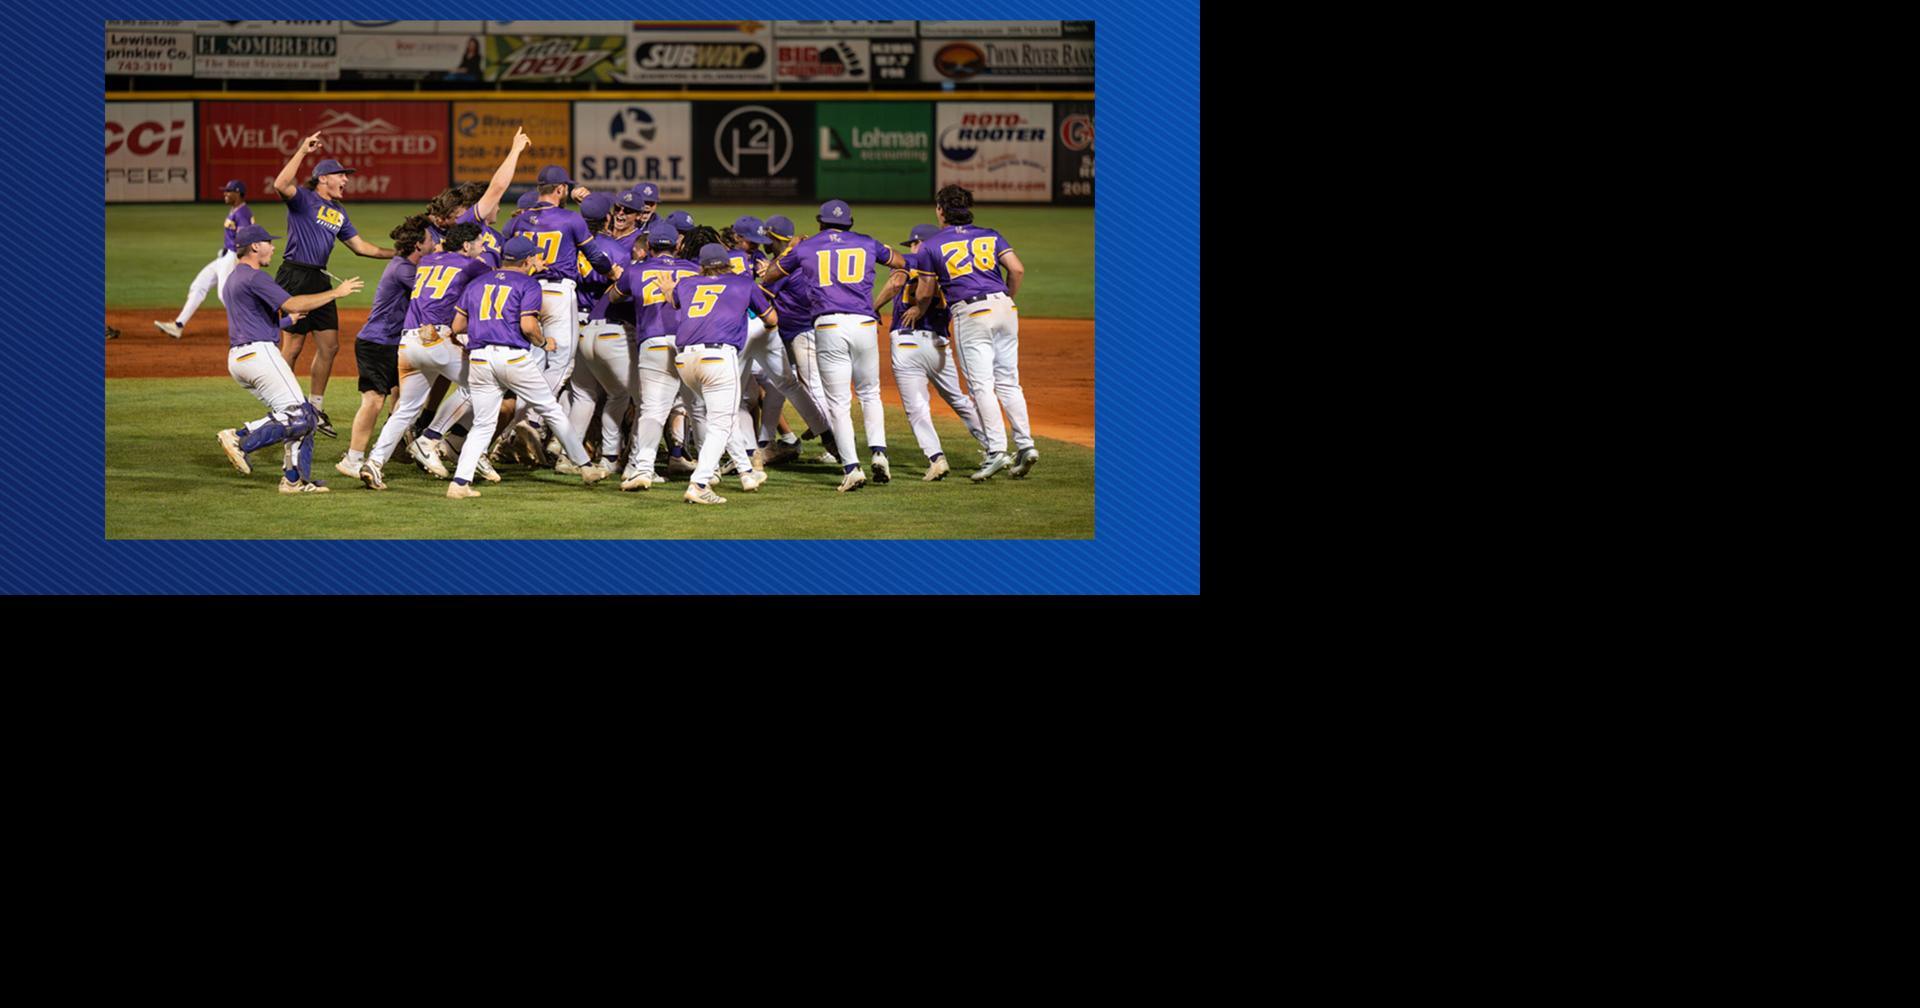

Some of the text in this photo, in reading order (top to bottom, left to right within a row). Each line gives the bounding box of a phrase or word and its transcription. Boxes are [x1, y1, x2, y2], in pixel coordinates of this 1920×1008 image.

[112, 34, 176, 46] Lewiston
[199, 37, 335, 54] EL SOMBRERO
[106, 48, 190, 61] prinkler Co.
[640, 44, 758, 67] SUBWAY
[779, 47, 817, 62] BIG
[985, 44, 1018, 65] TWIN
[1021, 44, 1058, 65] RIVER
[118, 61, 173, 71] 743-3191
[852, 127, 927, 148] Lohman
[959, 128, 1046, 142] ROOTER
[861, 149, 928, 162] accounting
[582, 157, 685, 180] S.P.O.R.T.
[816, 248, 867, 287] 10
[941, 236, 997, 279] 28
[478, 283, 512, 321] 11
[688, 285, 727, 319] 5
